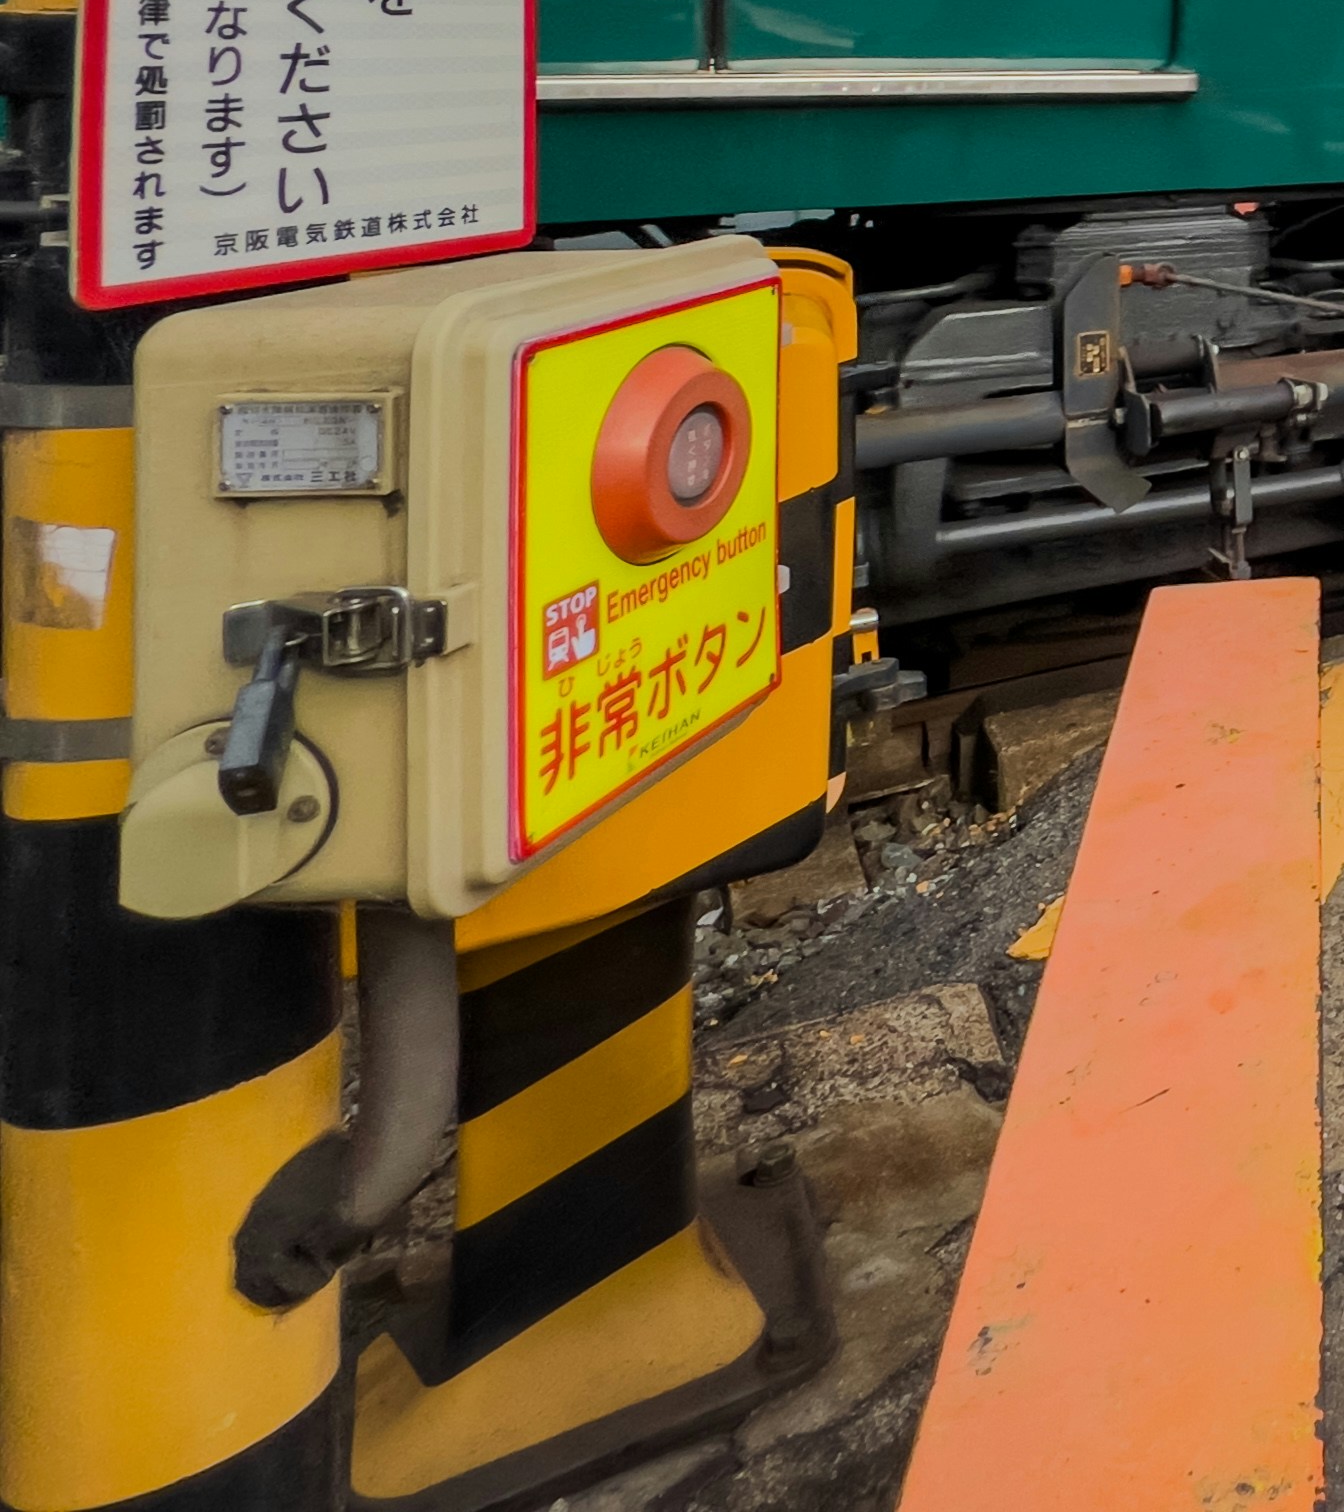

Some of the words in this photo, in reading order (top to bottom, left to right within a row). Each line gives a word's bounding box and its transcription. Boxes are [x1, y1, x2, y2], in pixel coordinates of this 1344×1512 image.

[213, 203, 480, 256] 京阪電気鉄道株式会社
[607, 551, 712, 625] Emergency
[716, 522, 767, 566] button
[545, 585, 598, 628] STOP
[558, 675, 576, 698] ひ
[596, 636, 643, 678] じょう
[538, 605, 767, 797] 非常ボタン
[638, 707, 702, 759] KEIHAN
